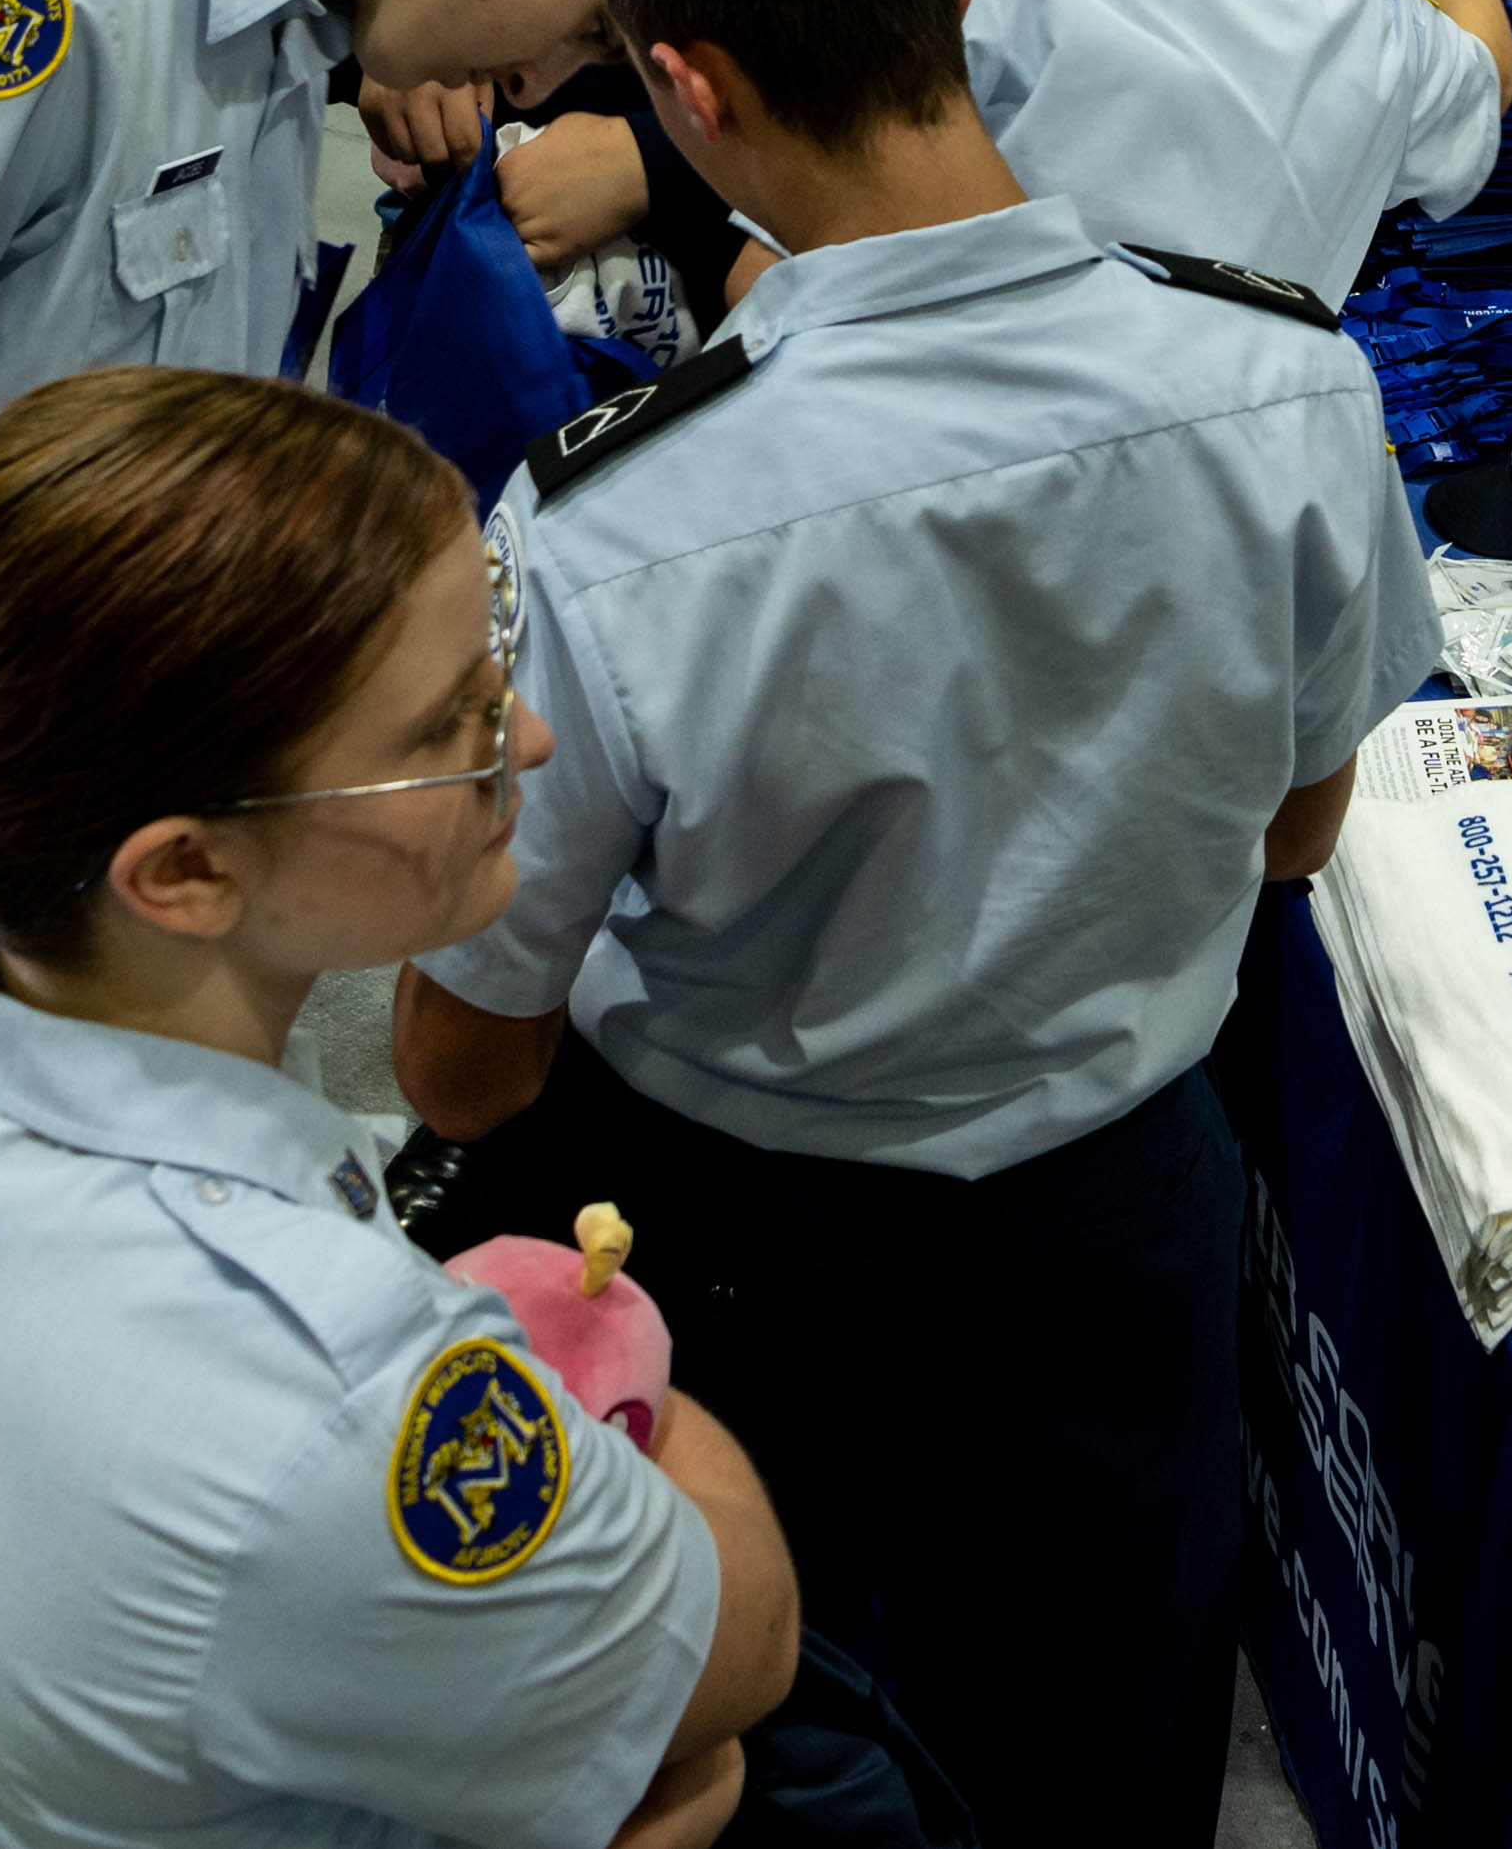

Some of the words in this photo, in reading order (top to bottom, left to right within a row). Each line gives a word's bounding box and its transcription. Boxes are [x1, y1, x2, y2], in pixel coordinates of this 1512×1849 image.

[1415, 718, 1435, 736] BE
[1437, 717, 1455, 746] JOIN
[1418, 738, 1435, 750] A
[1444, 746, 1463, 769] THE
[1451, 768, 1468, 787] AIR
